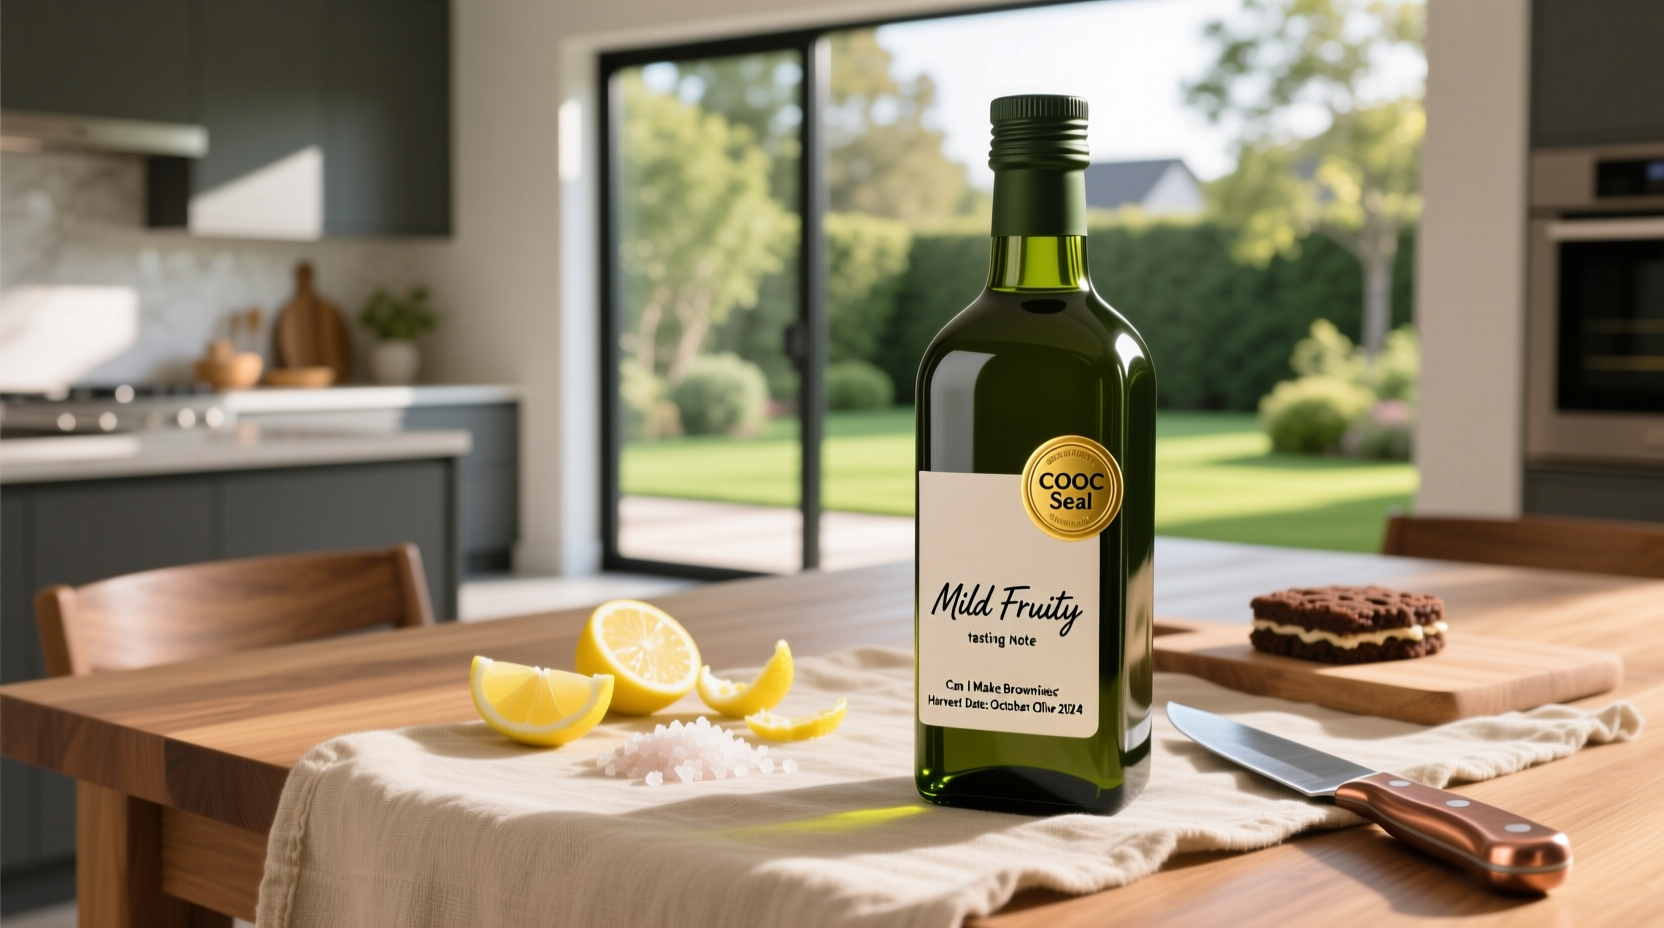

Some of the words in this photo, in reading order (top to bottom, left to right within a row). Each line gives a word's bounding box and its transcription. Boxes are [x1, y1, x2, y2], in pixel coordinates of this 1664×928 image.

[1038, 472, 1105, 491] COOC
[1049, 491, 1092, 510] Seal
[931, 582, 995, 620] Mild
[1000, 585, 1083, 637] Fruity
[1009, 634, 1037, 647] Note
[967, 680, 971, 692] I
[973, 681, 1002, 694] Make
